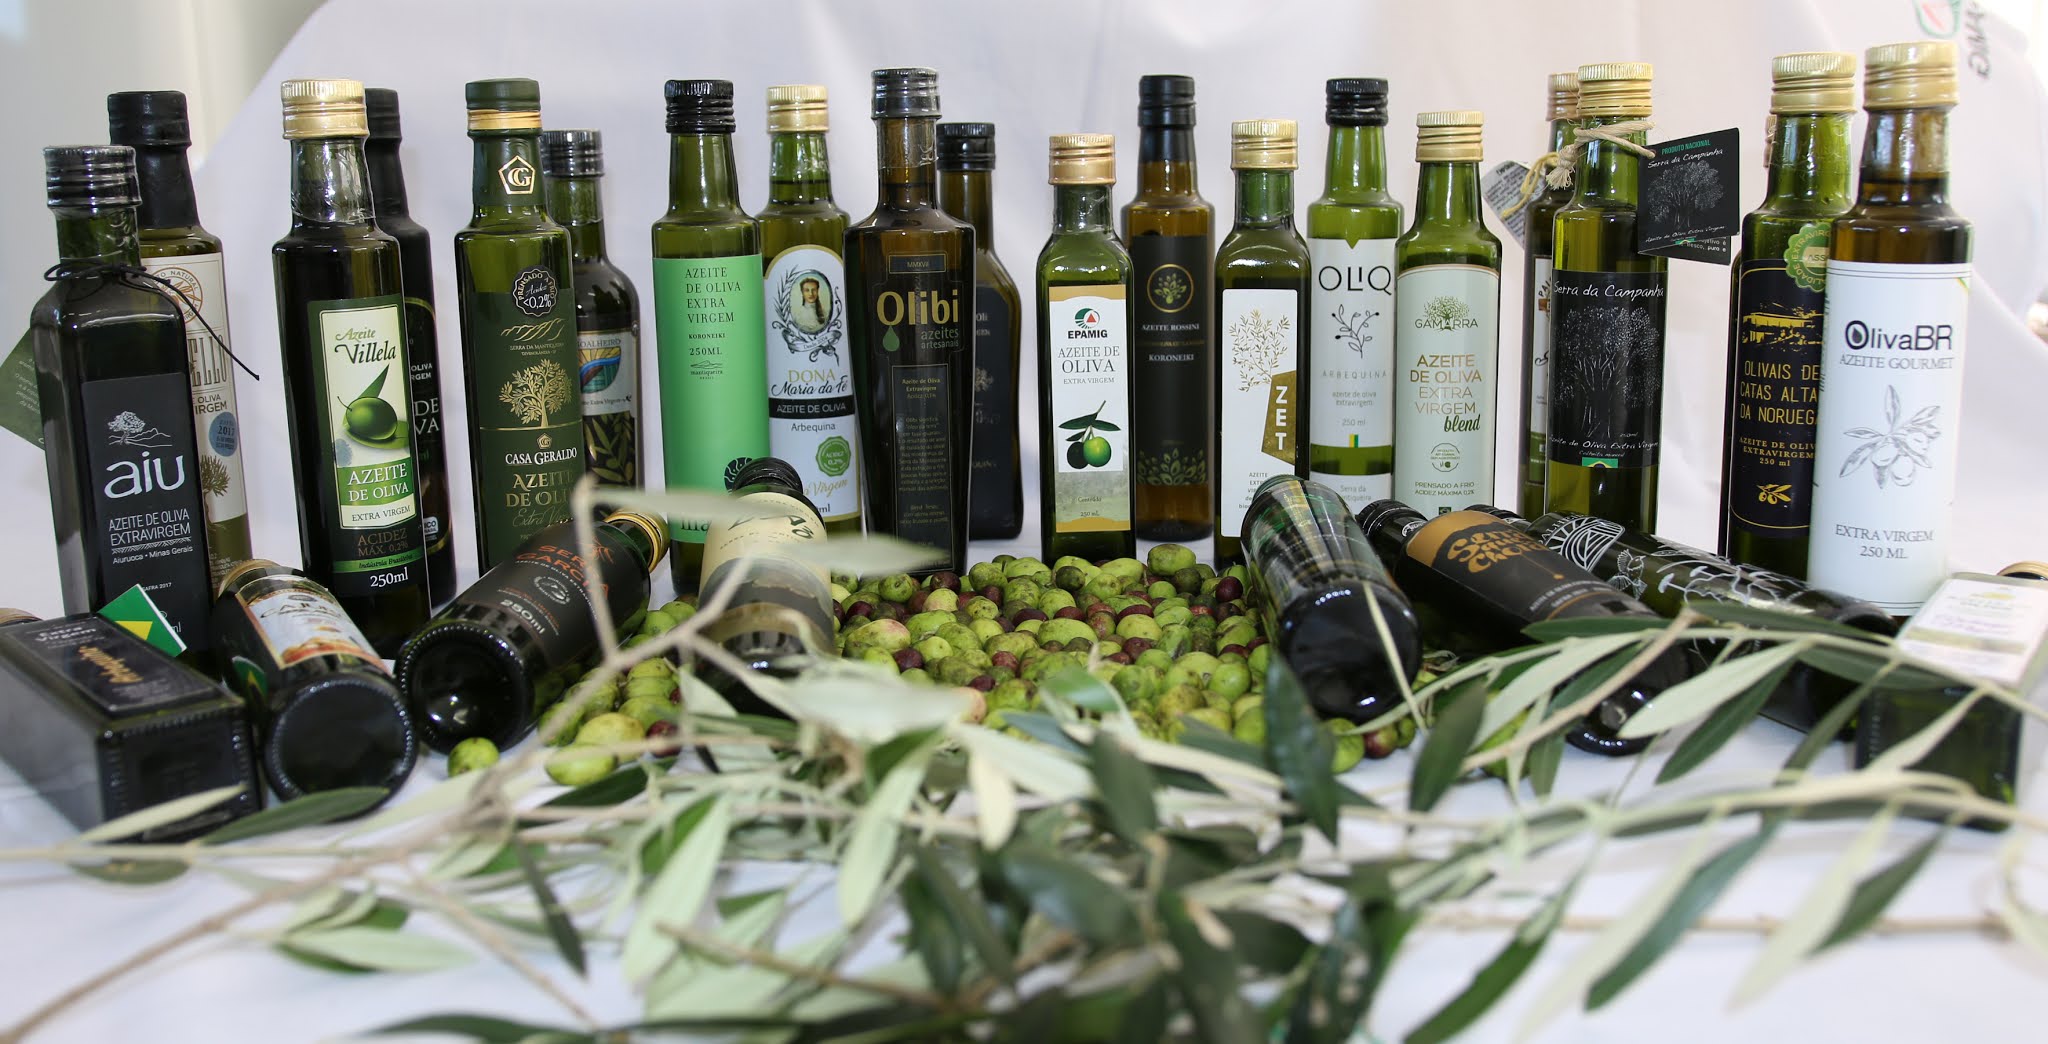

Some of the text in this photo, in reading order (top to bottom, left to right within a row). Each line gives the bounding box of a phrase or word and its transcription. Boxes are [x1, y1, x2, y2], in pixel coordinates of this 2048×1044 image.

[1661, 139, 1711, 155] PRODUTO NACIONAL
[1648, 148, 1723, 168] Serra da Campanha
[1791, 229, 1831, 261] EXTRAVIRG
[685, 267, 728, 279] AZEITE
[171, 270, 199, 291] NATURAL
[517, 273, 543, 301] PRENSADO
[686, 281, 741, 294] DE OLIVA
[1318, 265, 1392, 296] OLIQ
[1553, 280, 1665, 301] Serra da Campanha
[687, 298, 726, 309] EXTRA
[876, 289, 959, 326] Olibi
[687, 312, 735, 324] VIRGEM
[1415, 318, 1478, 330] GAMARRA
[921, 326, 959, 340] azeites
[1067, 329, 1108, 339] EPAMIG
[1141, 323, 1200, 331] AZEITE ROSSINI
[335, 327, 376, 343] Azeite
[1845, 320, 1953, 351] OlivaBR
[577, 338, 622, 348] OALHEIRO
[921, 340, 959, 350] artesanais
[334, 340, 397, 364] Villela
[689, 347, 723, 356] 250ML
[1058, 346, 1120, 358] AZEITE DE
[1148, 353, 1194, 361] KORONEIKI
[187, 334, 227, 388] ELLO
[411, 362, 433, 372] OLIVA
[1062, 359, 1116, 373] OLIVA
[1416, 354, 1475, 367] AZEITE
[1839, 353, 1955, 370] AZEITE GOURMET
[411, 372, 432, 381] RGEM
[788, 369, 836, 383] DONA
[1322, 370, 1387, 380] ARBEQUINA
[1410, 369, 1482, 383] DE OLIVA
[1745, 360, 1820, 381] OLIVAIS DE
[771, 375, 849, 396] Maria da Fé
[1419, 386, 1473, 399] EXTRA
[1740, 381, 1818, 403] CATAS ALTA
[197, 394, 222, 404] OLIVA
[1332, 390, 1377, 398] azeite de oliva
[194, 401, 228, 415] IRGEM
[414, 397, 439, 417] DE
[776, 402, 847, 414] AZEITE DE OLIVA
[1336, 399, 1373, 408] extravirgem
[1415, 402, 1476, 414] VIRGEM
[1275, 385, 1288, 451] ZET
[1740, 403, 1817, 425] DA NORUEG
[791, 422, 836, 433] Arbequina
[1444, 414, 1481, 432] blend
[218, 425, 235, 436] 2017
[1582, 440, 1607, 449] Oliva
[1610, 442, 1636, 450] Extra
[1739, 436, 1815, 450] AZEITE DE OLIV
[505, 453, 533, 466] CASA
[1743, 446, 1815, 459] EXTRAVIRGEM
[1779, 458, 1791, 467] ml
[104, 451, 186, 499] aiu
[347, 463, 408, 485] AZEITE
[349, 482, 409, 502] DE OLIVA
[812, 478, 848, 498] Virgem
[1340, 485, 1357, 493] Serra
[1415, 481, 1451, 489] PRENSADO
[505, 492, 532, 507] DE
[1342, 493, 1372, 502] ntiqueira
[109, 508, 190, 531] AZEITE DE OLIVA
[352, 505, 411, 522] EXTRA VIRGEM
[512, 508, 543, 527] Extra
[110, 522, 191, 546] EXTRAVIRGEM
[357, 528, 408, 546] ACIDEZ
[1835, 524, 1934, 542] EXTRA VIRGEM
[113, 545, 193, 564] Aiuruoca Minas Gerais
[1860, 545, 1908, 559] 250 ML
[370, 567, 409, 588] 250ml
[500, 599, 546, 634] 250ml
